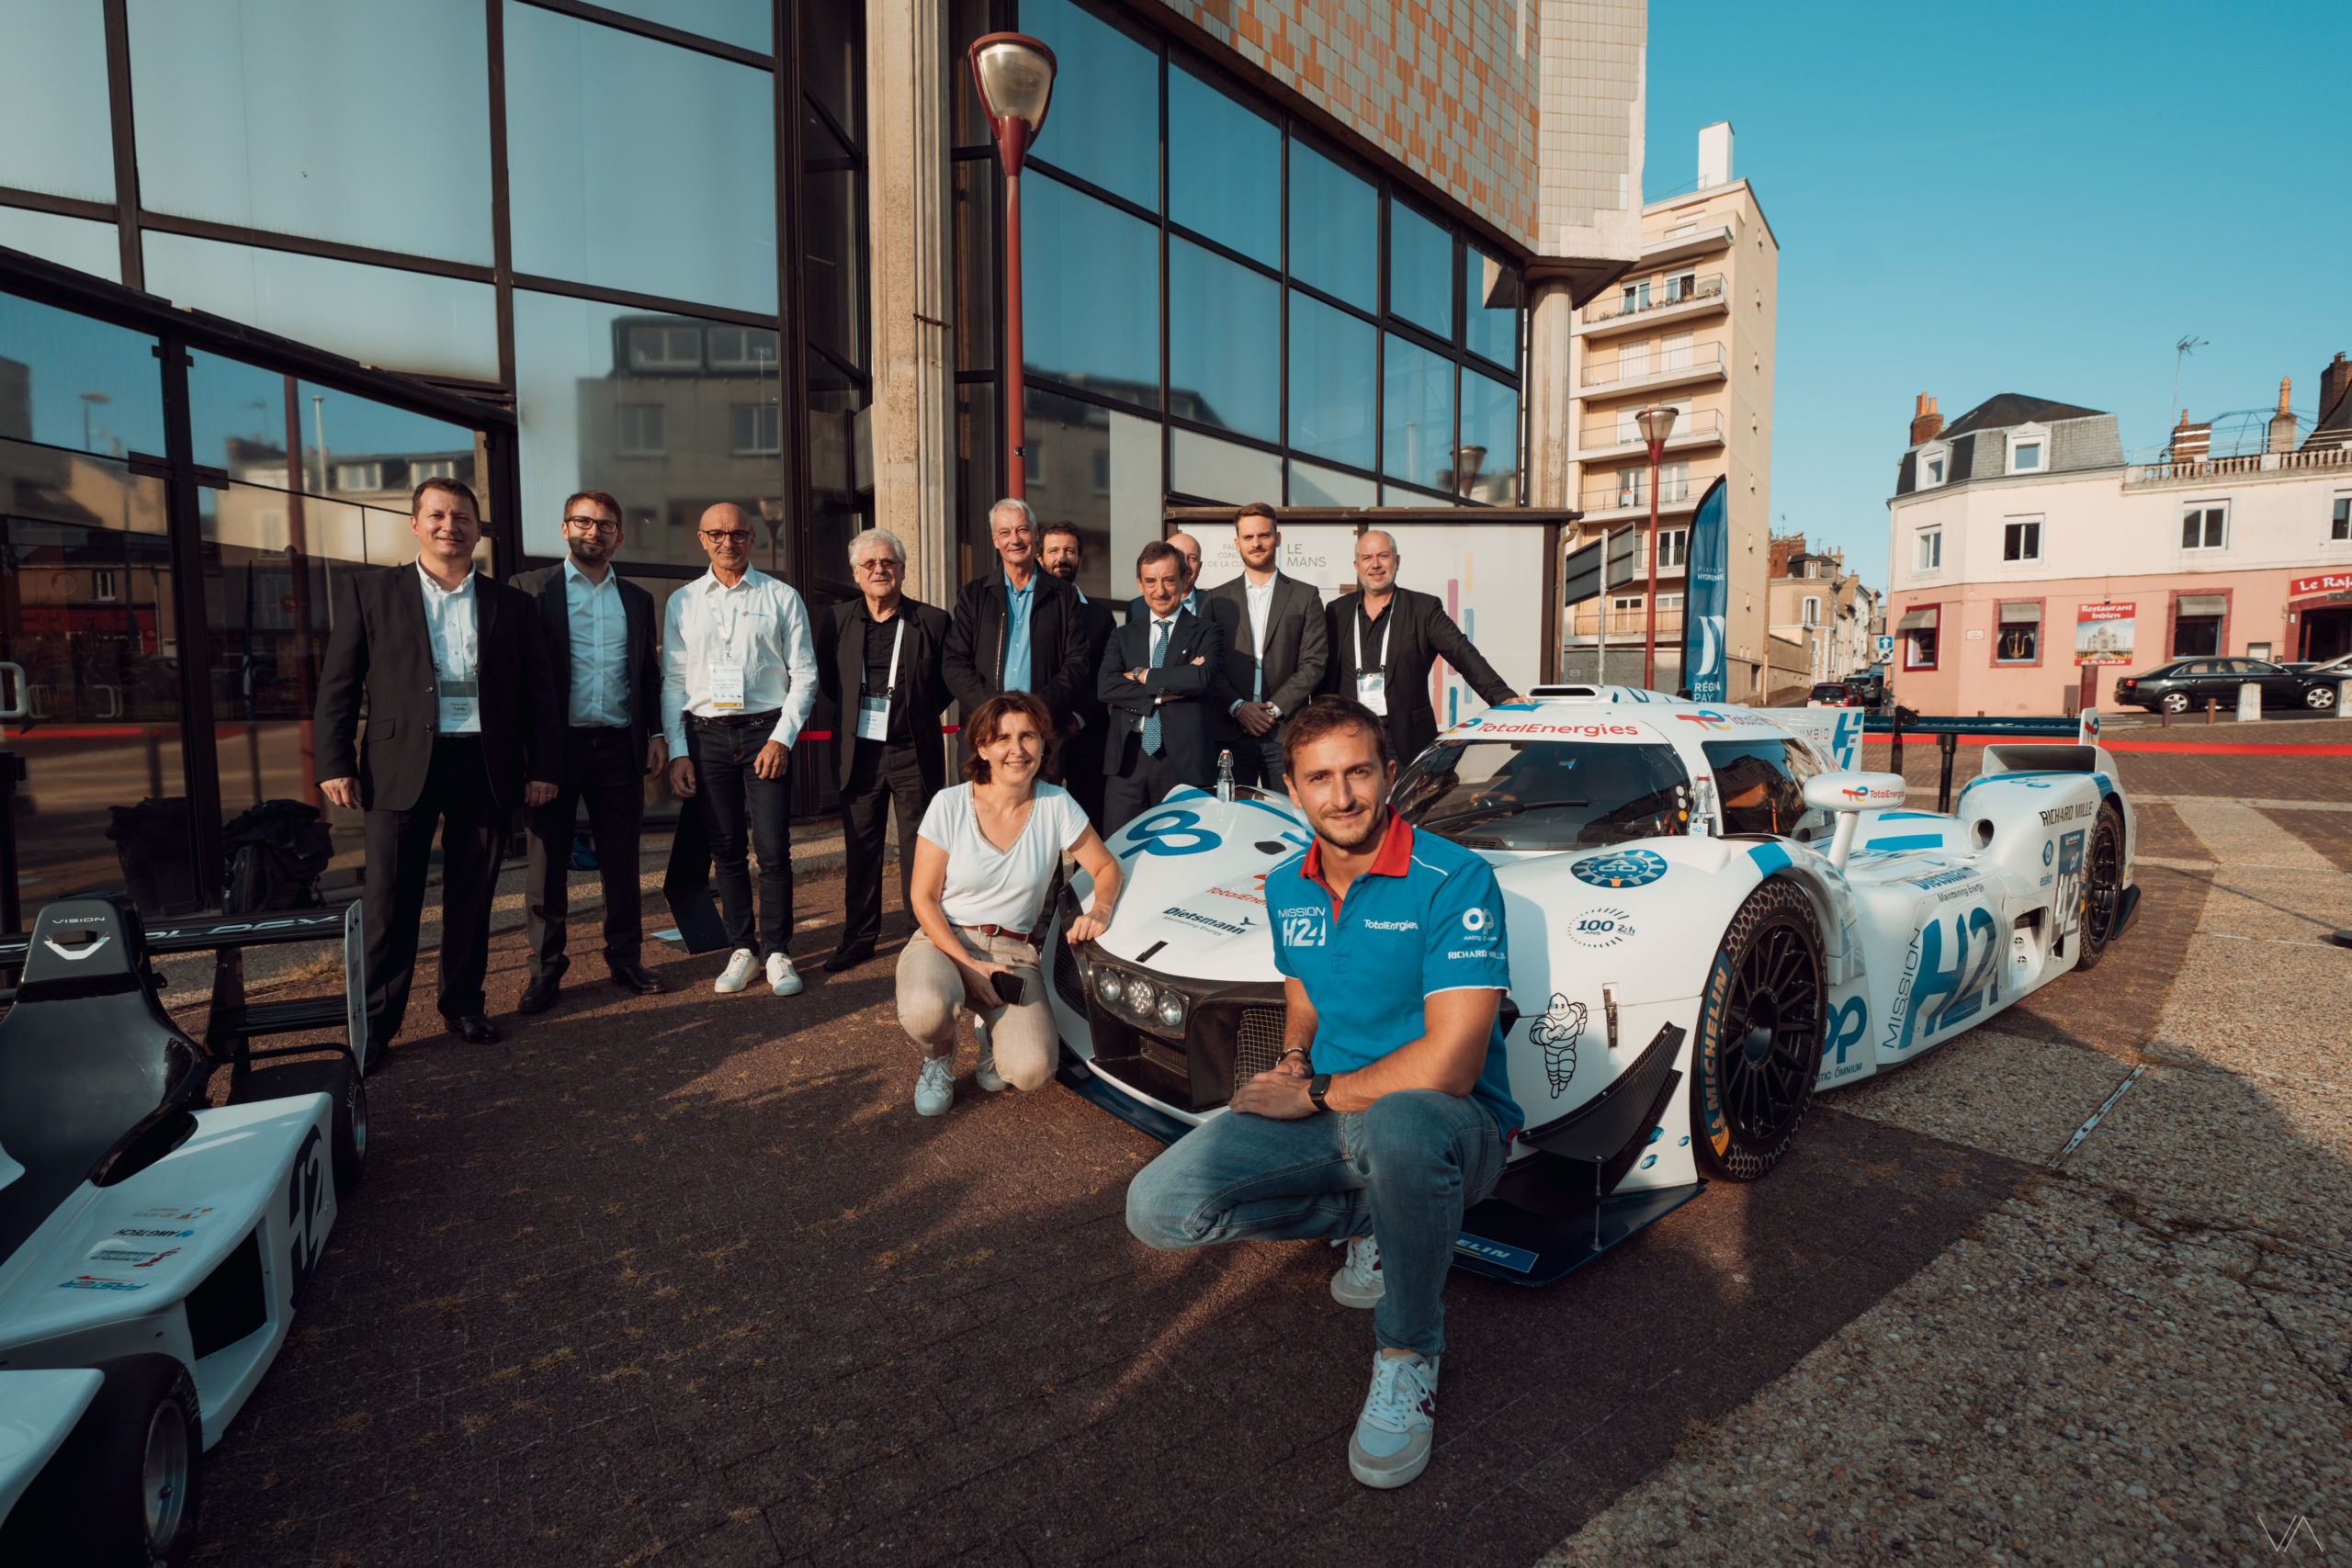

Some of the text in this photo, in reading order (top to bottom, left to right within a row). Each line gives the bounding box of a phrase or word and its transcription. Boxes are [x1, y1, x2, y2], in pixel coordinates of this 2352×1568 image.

[1287, 544, 1303, 555] LE
[1287, 557, 1327, 568] MANS
[2300, 576, 2352, 592] Le Raj
[1476, 721, 1639, 737] TotalEnergies
[2039, 801, 2094, 827] RICHARD MILLE
[1205, 886, 1267, 908] TotalEner
[2055, 873, 2080, 936] 42
[1278, 906, 1326, 918] MISSION
[1162, 908, 1247, 934] Dietsmann
[1577, 919, 1614, 931] 100
[1448, 950, 1487, 960] RICHARD
[1882, 928, 1920, 1049] MISSION
[1704, 966, 1728, 1111] MICHELIN
[1815, 1071, 1832, 1084] STIC
[1454, 1239, 1511, 1258] ELIN
